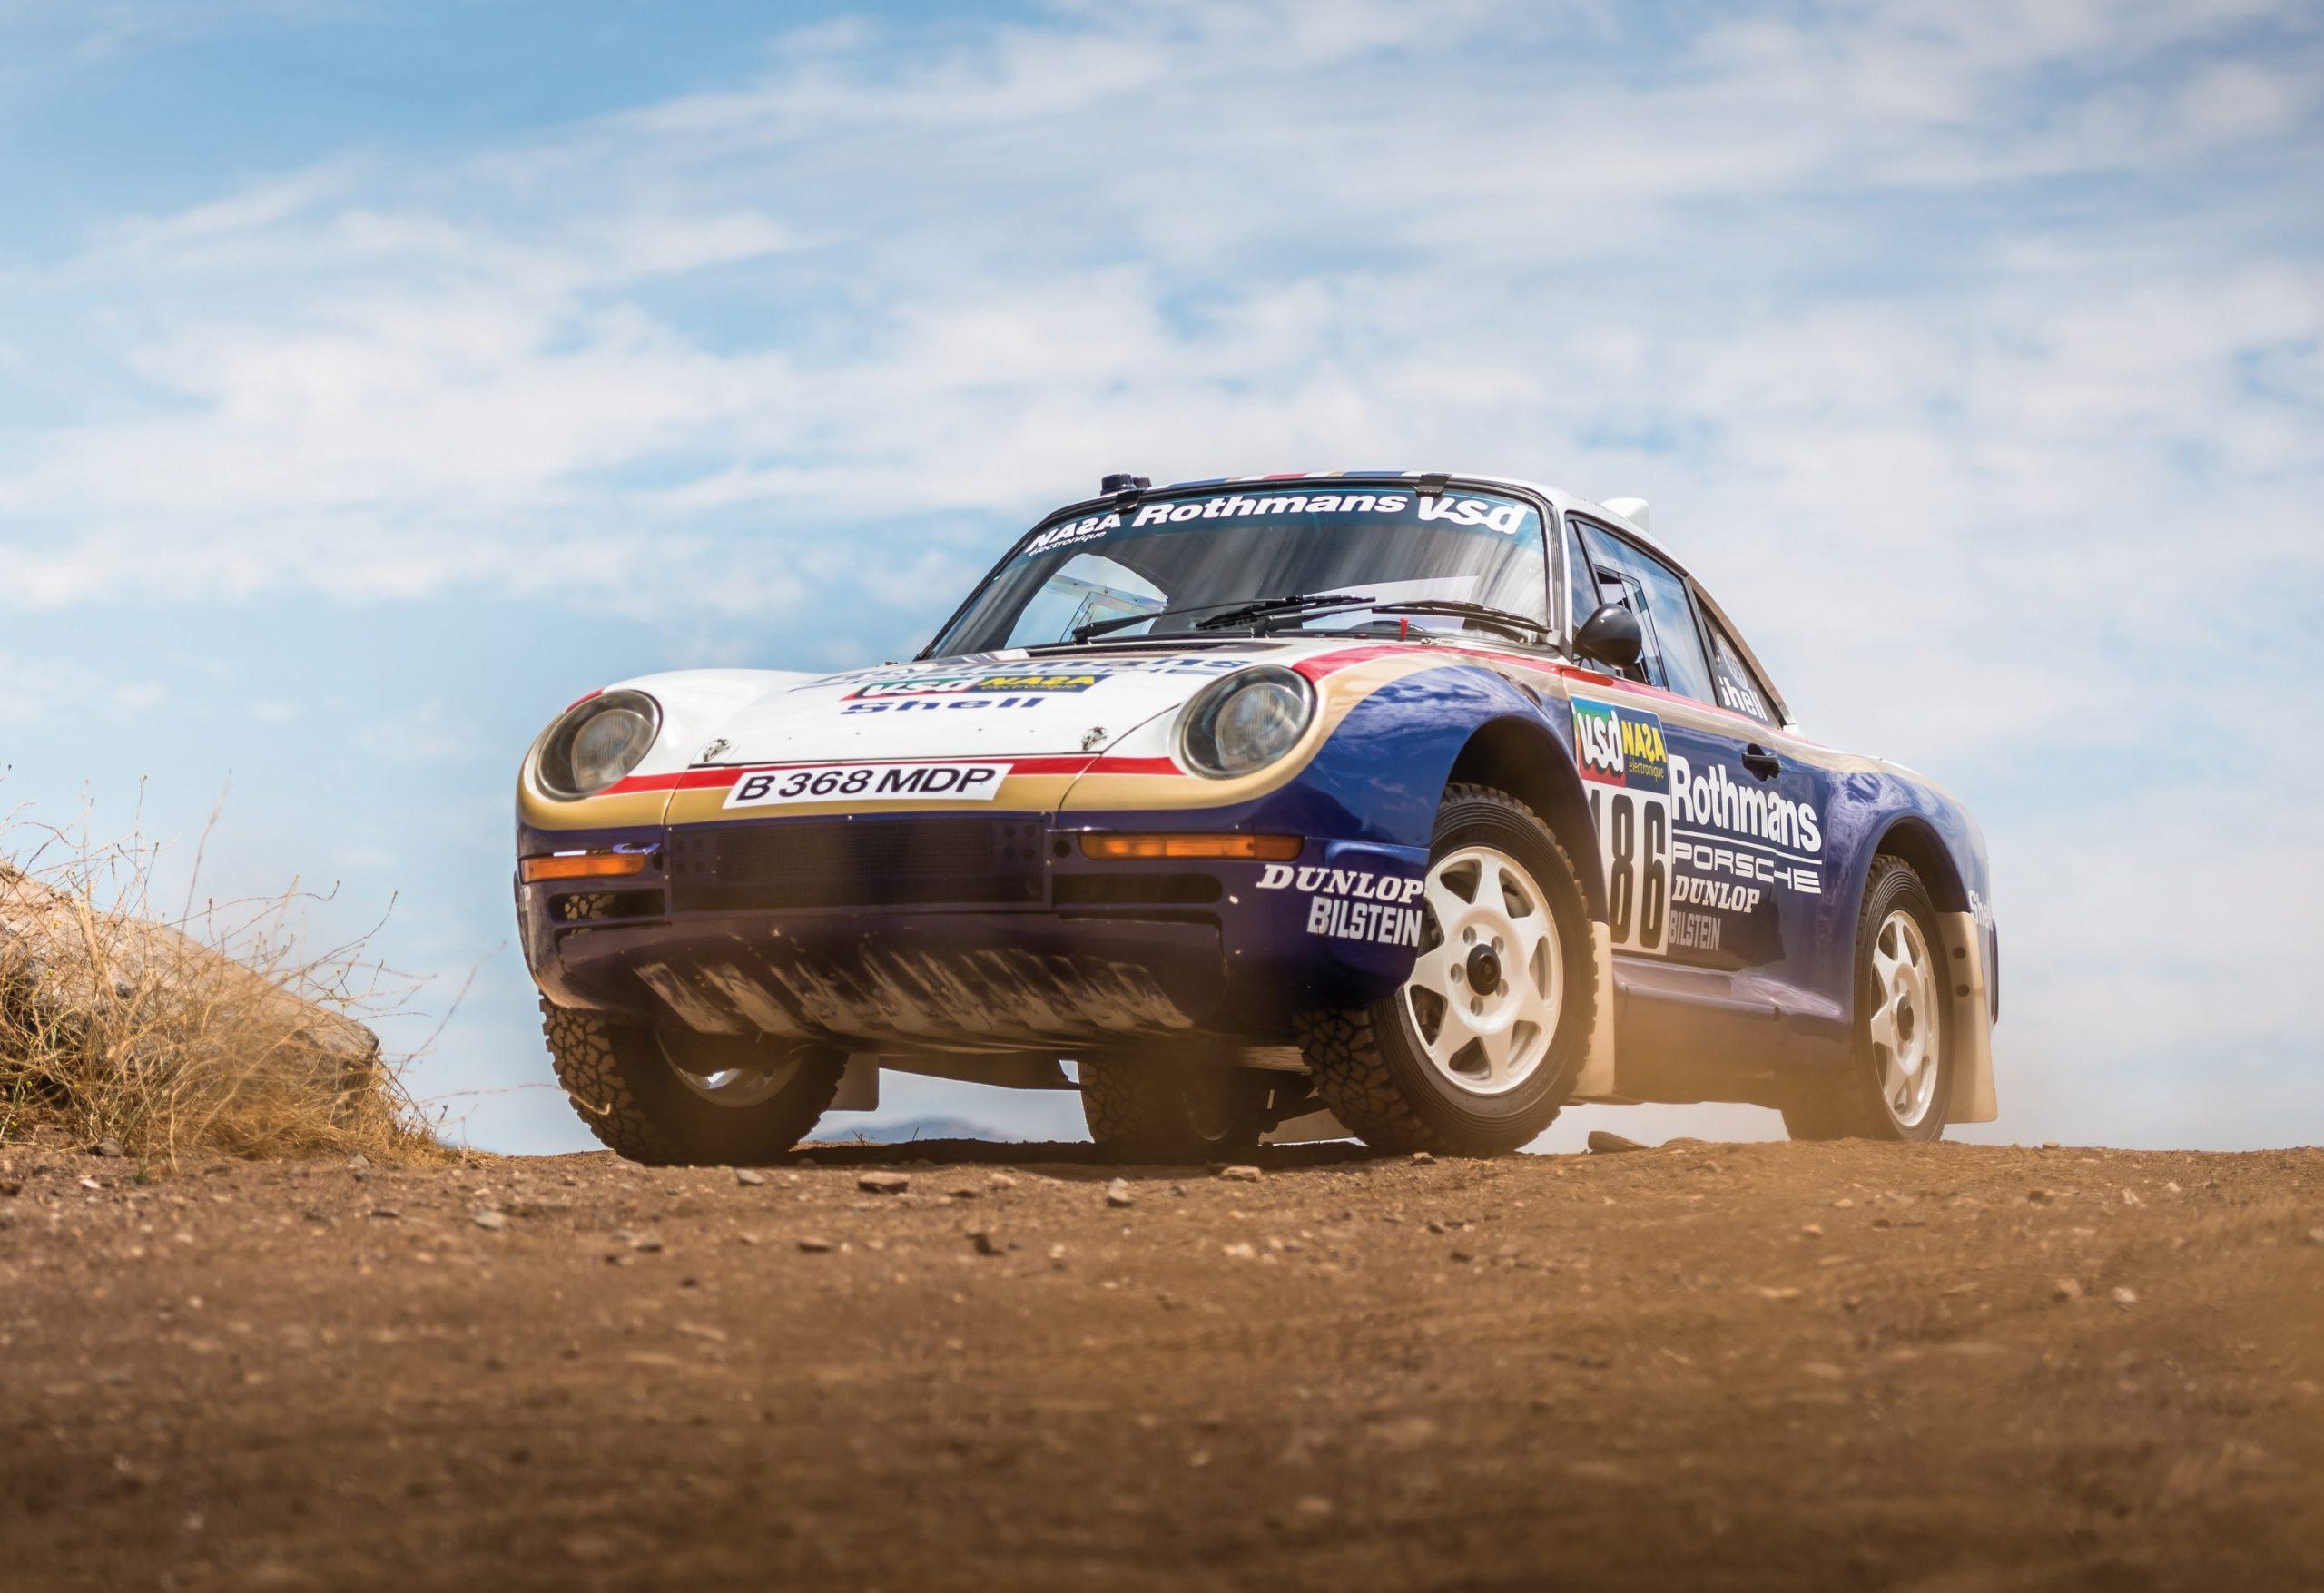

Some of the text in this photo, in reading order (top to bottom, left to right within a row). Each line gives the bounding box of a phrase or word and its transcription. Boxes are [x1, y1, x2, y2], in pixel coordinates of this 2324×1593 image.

[1131, 494, 1406, 527] Rothmans
[841, 697, 1046, 714] Shell
[736, 768, 997, 801] B 368 MDP
[1669, 754, 1822, 853] Rothmans
[1256, 864, 1423, 903] DUNLOP
[1672, 841, 1822, 894] PORSCHE
[1671, 874, 1760, 914] DUNLOP
[1306, 896, 1423, 948] BILSTEIN
[1668, 910, 1721, 951] BILSTEIN
